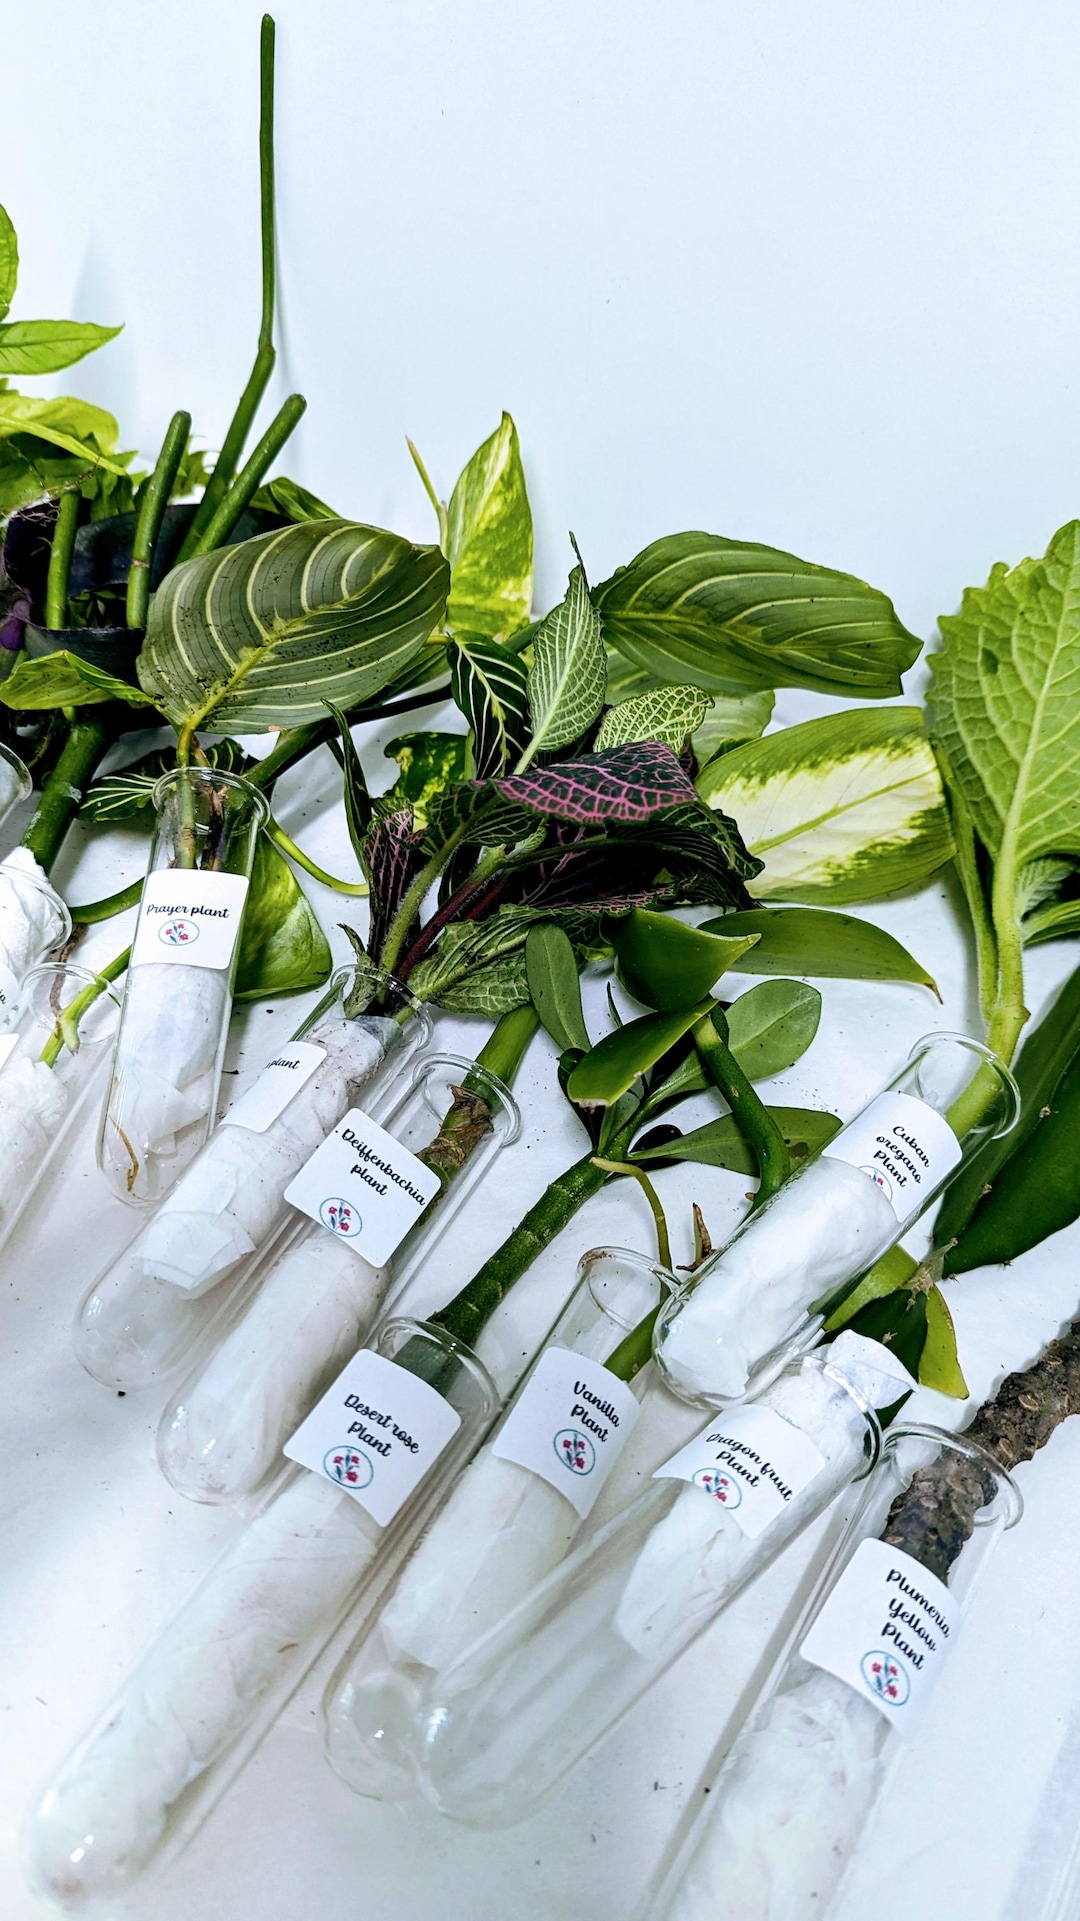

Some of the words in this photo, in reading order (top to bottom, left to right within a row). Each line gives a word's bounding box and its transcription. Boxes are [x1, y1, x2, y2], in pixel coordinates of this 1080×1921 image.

[190, 905, 229, 918] plant
[341, 1128, 426, 1206] Deiffenbachia
[876, 1136, 921, 1184] oregano
[893, 1126, 929, 1167] Cuban
[344, 1393, 393, 1428] Desert
[391, 1423, 419, 1454] rose
[570, 1404, 609, 1443] Plant
[573, 1380, 620, 1428] Vanilla
[347, 1421, 392, 1457] Plant
[706, 1433, 762, 1465] Dragon
[760, 1462, 793, 1501] fruit
[716, 1450, 760, 1487] Plant
[886, 1568, 950, 1638] Plumeria
[889, 1598, 936, 1651] Yellow
[881, 1622, 924, 1670] Plant
